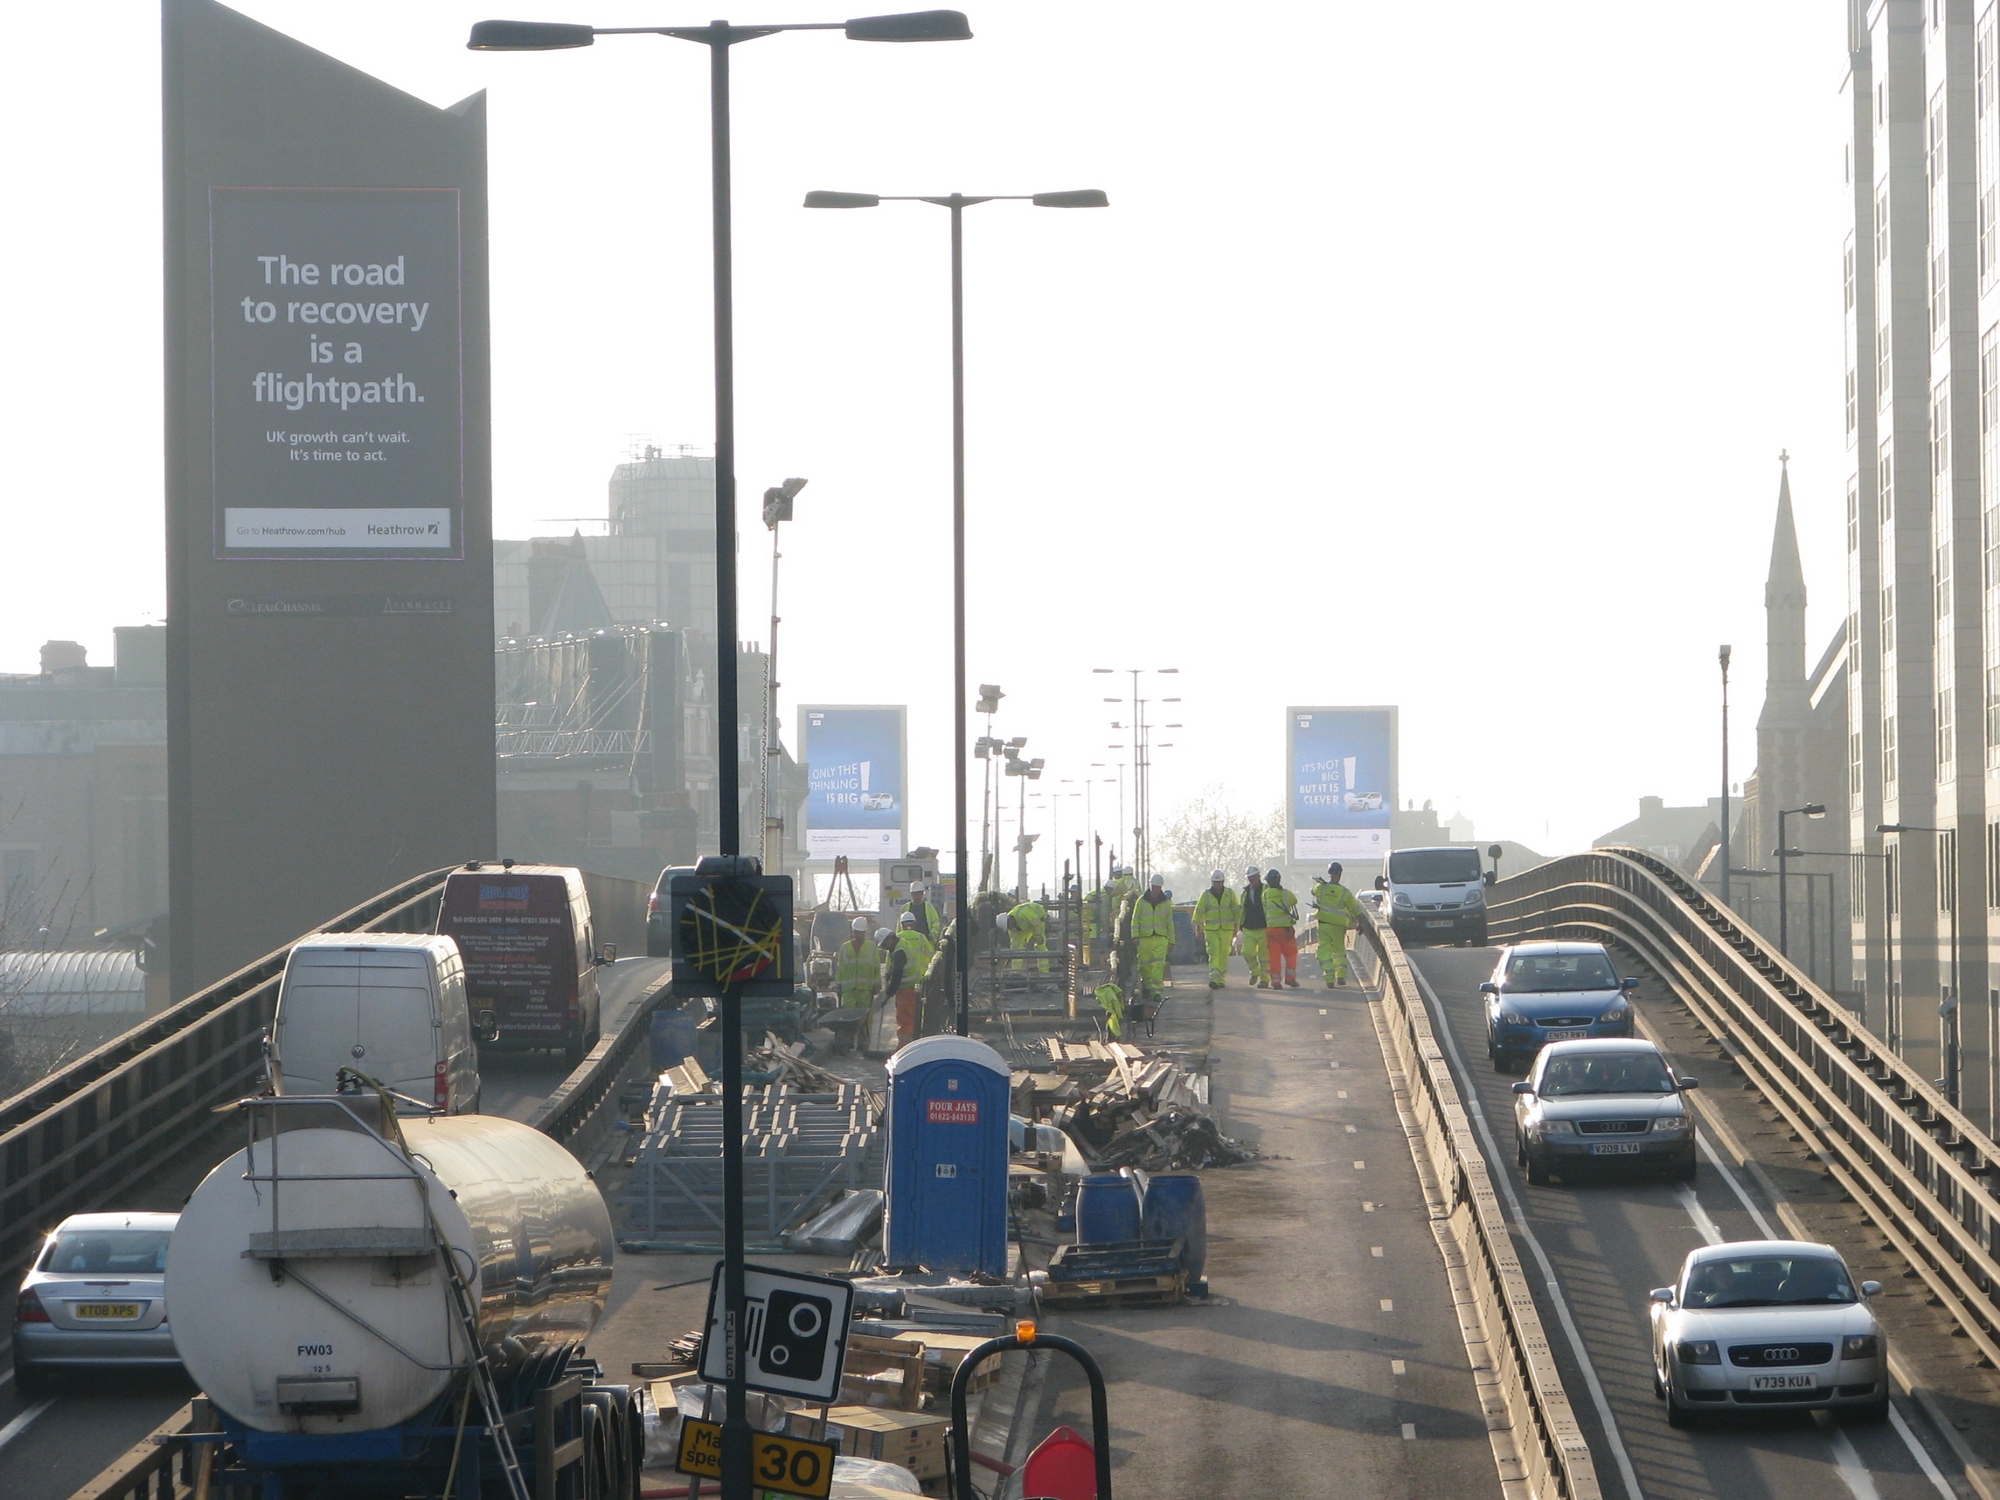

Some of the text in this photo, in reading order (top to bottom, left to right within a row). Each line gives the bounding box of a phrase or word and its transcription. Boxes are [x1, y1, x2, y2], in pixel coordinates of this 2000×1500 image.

[257, 254, 405, 285] The road
[241, 296, 429, 332] to recovery
[310, 334, 362, 363] is a
[252, 371, 425, 410] flightpath.
[266, 431, 410, 445] UK growth can't wait.
[290, 449, 387, 461] It's time to act.
[237, 526, 346, 536] Go to Heathrow.com/hub
[367, 524, 425, 536] Heathrow
[812, 762, 858, 779] ONLY THE
[1302, 759, 1340, 773] IT'S NOT
[1322, 771, 1339, 782] BIG
[811, 778, 859, 791] THINKING
[1300, 783, 1339, 794] BUT IT IS
[827, 792, 858, 804] IS BIG
[1304, 795, 1339, 804] CLEVER
[479, 884, 529, 901] MIDLANDS
[930, 1101, 977, 1112] FOUR JAYS
[1595, 1143, 1639, 1153] V209 LYA
[80, 1304, 134, 1316] KT08 XPS
[297, 1344, 333, 1356] FW03
[1755, 1375, 1811, 1389] V739 KUA
[695, 1429, 721, 1447] Ma
[686, 1450, 721, 1467] spe
[759, 1443, 821, 1487] 30
